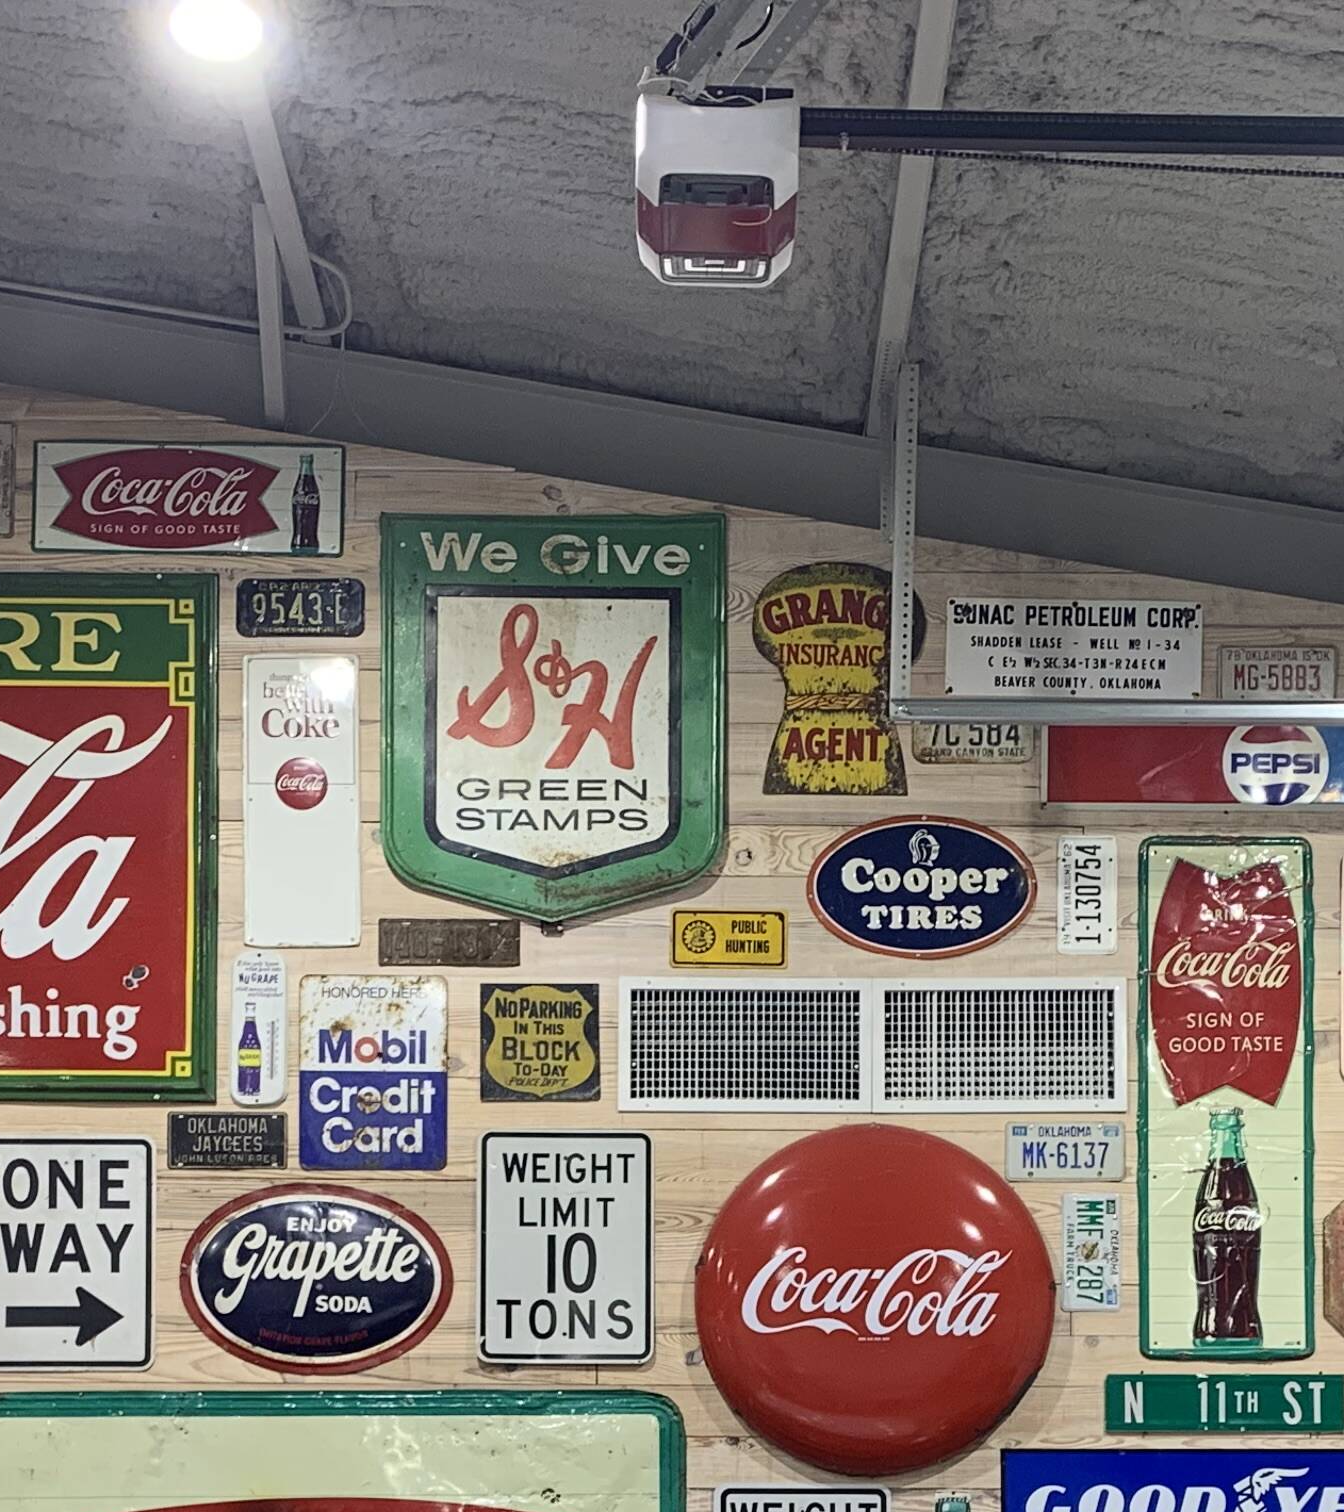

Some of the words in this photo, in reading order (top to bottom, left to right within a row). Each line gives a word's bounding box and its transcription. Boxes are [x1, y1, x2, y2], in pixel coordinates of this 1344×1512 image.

[81, 467, 255, 517] Coca-Cola
[90, 523, 125, 535] SIGN
[130, 523, 149, 535] OF
[154, 523, 197, 535] GOOD
[202, 523, 241, 536] TASTE
[421, 531, 517, 573] We
[541, 533, 691, 577] Give
[1026, 606, 1136, 627] PETROLEUM
[1099, 677, 1161, 690] OKLAHOMA
[262, 708, 340, 739] Coke
[782, 727, 882, 764] AGENT
[1230, 753, 1320, 774] PEPSI
[457, 778, 647, 802] GREEN
[457, 808, 648, 832] STAMPS
[841, 857, 1009, 901] Cooper
[730, 919, 768, 936] PUBLIC
[861, 905, 983, 931] TIRES
[725, 938, 771, 956] HUNTING
[1156, 940, 1297, 996] Coca-Cola
[321, 986, 388, 999] HONORED
[1187, 1012, 1232, 1029] SIGN
[1240, 1012, 1265, 1029] OF
[319, 1028, 426, 1065] Mobil
[1168, 1036, 1226, 1054] GOOD
[1231, 1036, 1283, 1053] TASTE
[309, 1077, 436, 1114] Credit
[187, 1117, 269, 1134] OKLAHOMA
[322, 1117, 424, 1155] Card
[1038, 1126, 1092, 1137] OKLAHOMA
[192, 1135, 264, 1153] JAYCEES
[1022, 1142, 1109, 1169] MK-6137
[502, 1153, 635, 1184] WEIGHT
[3, 1159, 131, 1209] ONE
[286, 1216, 356, 1235] ENJOY
[519, 1197, 615, 1228] LIMIT
[1193, 1205, 1268, 1233] Coca-Cola
[2, 1223, 134, 1273] WAY
[214, 1224, 419, 1317] Grapette
[546, 1232, 596, 1295] 10
[315, 1294, 372, 1314] SODA
[742, 1246, 1012, 1338] Coca-Cola
[496, 1300, 633, 1340] TONS
[1123, 1382, 1144, 1423] N
[1197, 1382, 1259, 1423] 11TH
[1282, 1382, 1326, 1423] ST
